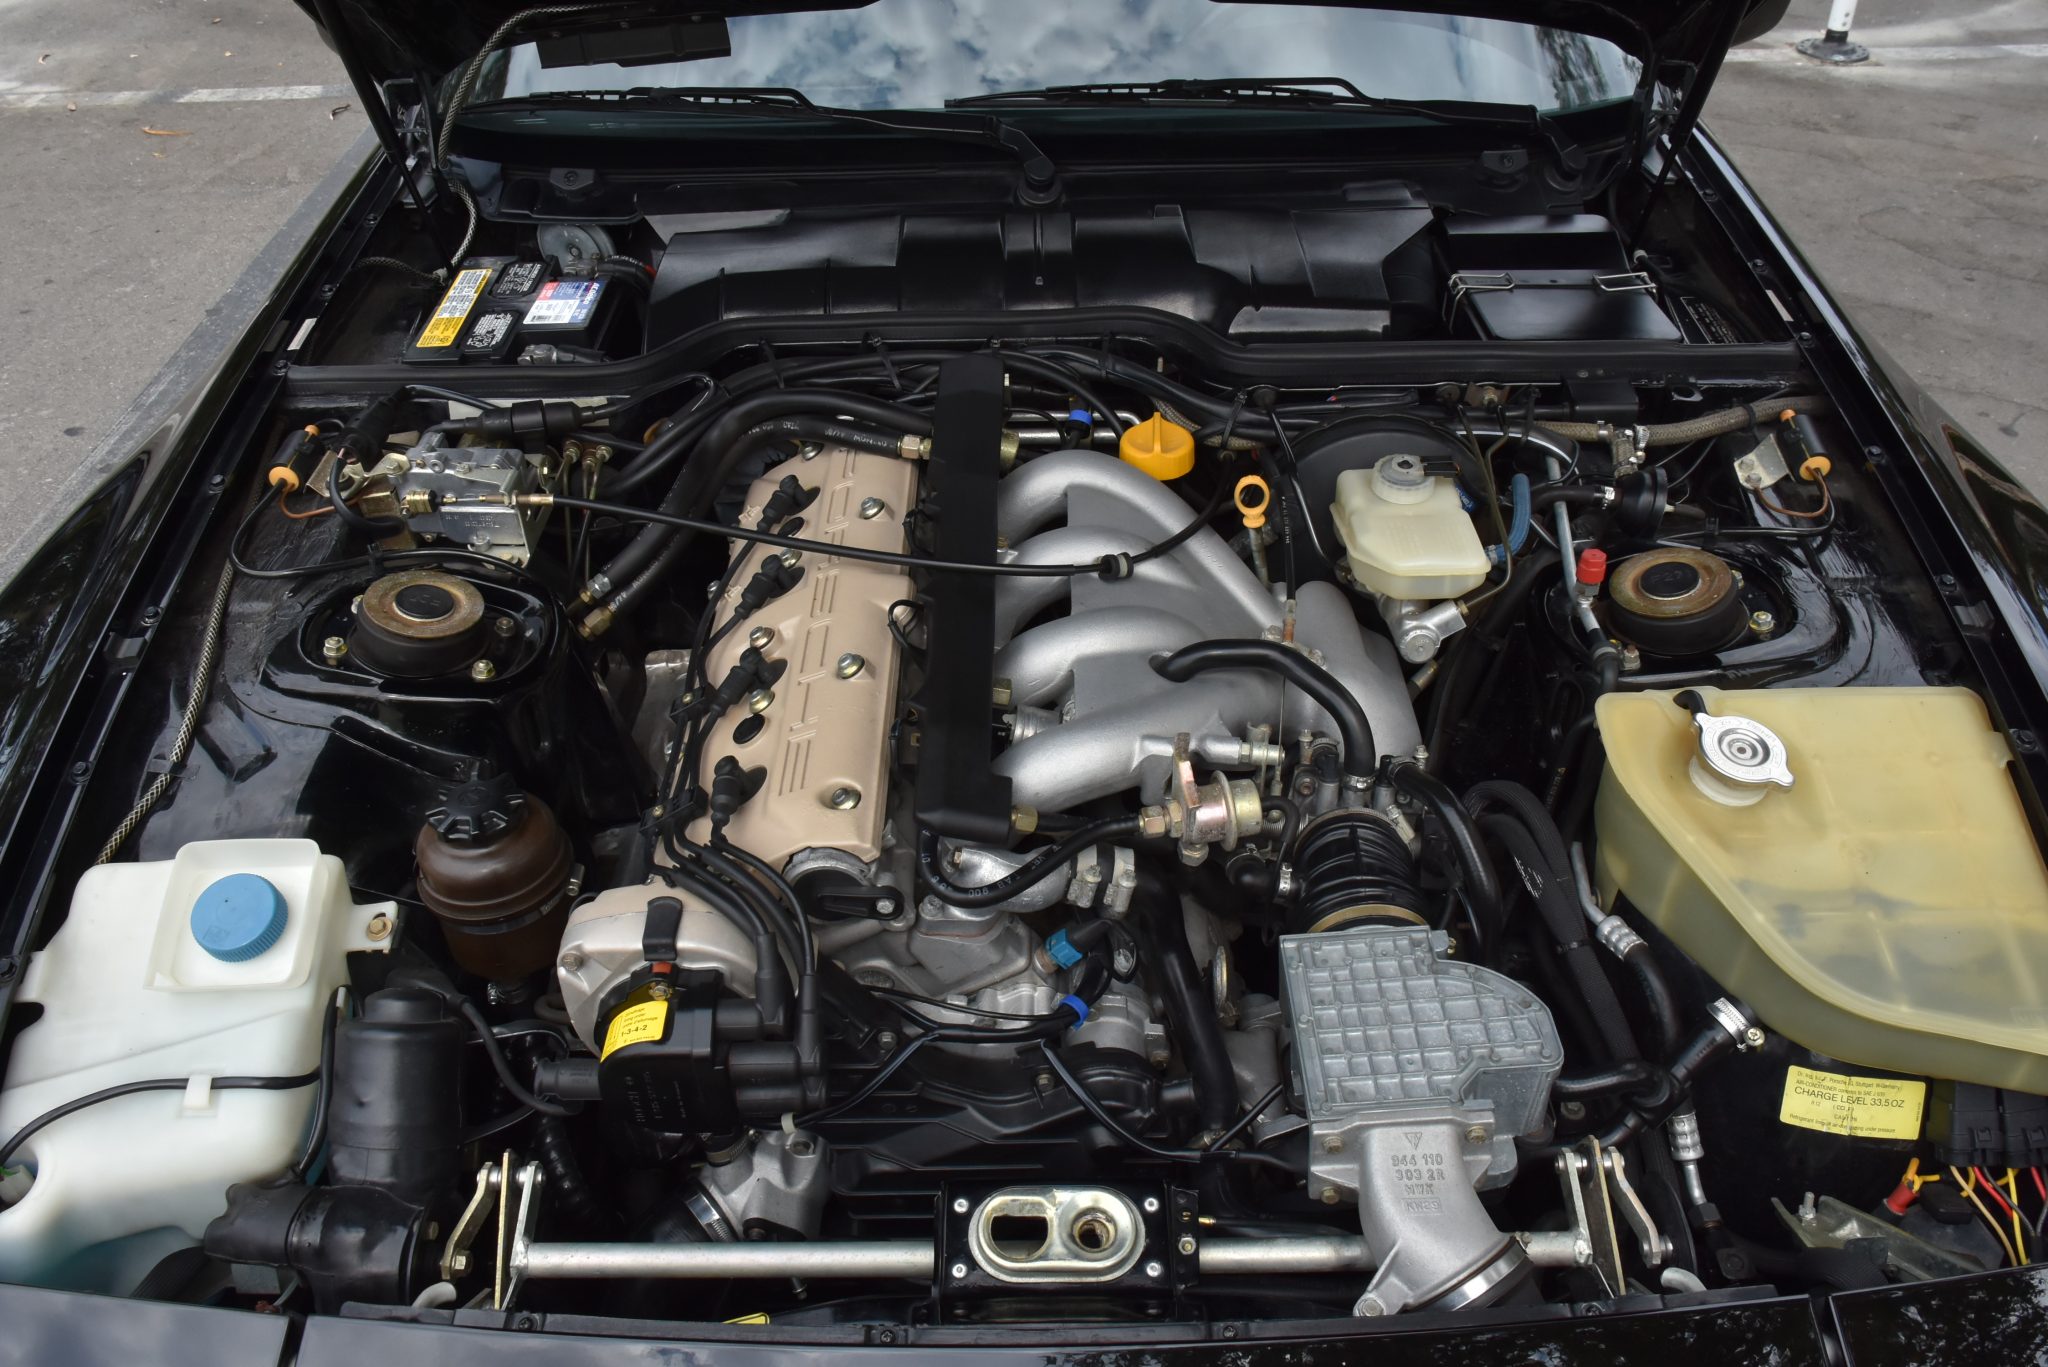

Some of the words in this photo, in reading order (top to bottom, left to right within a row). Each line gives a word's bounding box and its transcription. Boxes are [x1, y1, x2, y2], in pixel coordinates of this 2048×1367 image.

[621, 1025, 648, 1037] 1-3-4-2
[1794, 1086, 1839, 1102] CHARGE
[1840, 1095, 1868, 1106] LEVEL
[1391, 1154, 1417, 1167] 944
[1422, 1153, 1444, 1166] 110
[1395, 1168, 1422, 1181] 303
[1426, 1168, 1446, 1181] 2R
